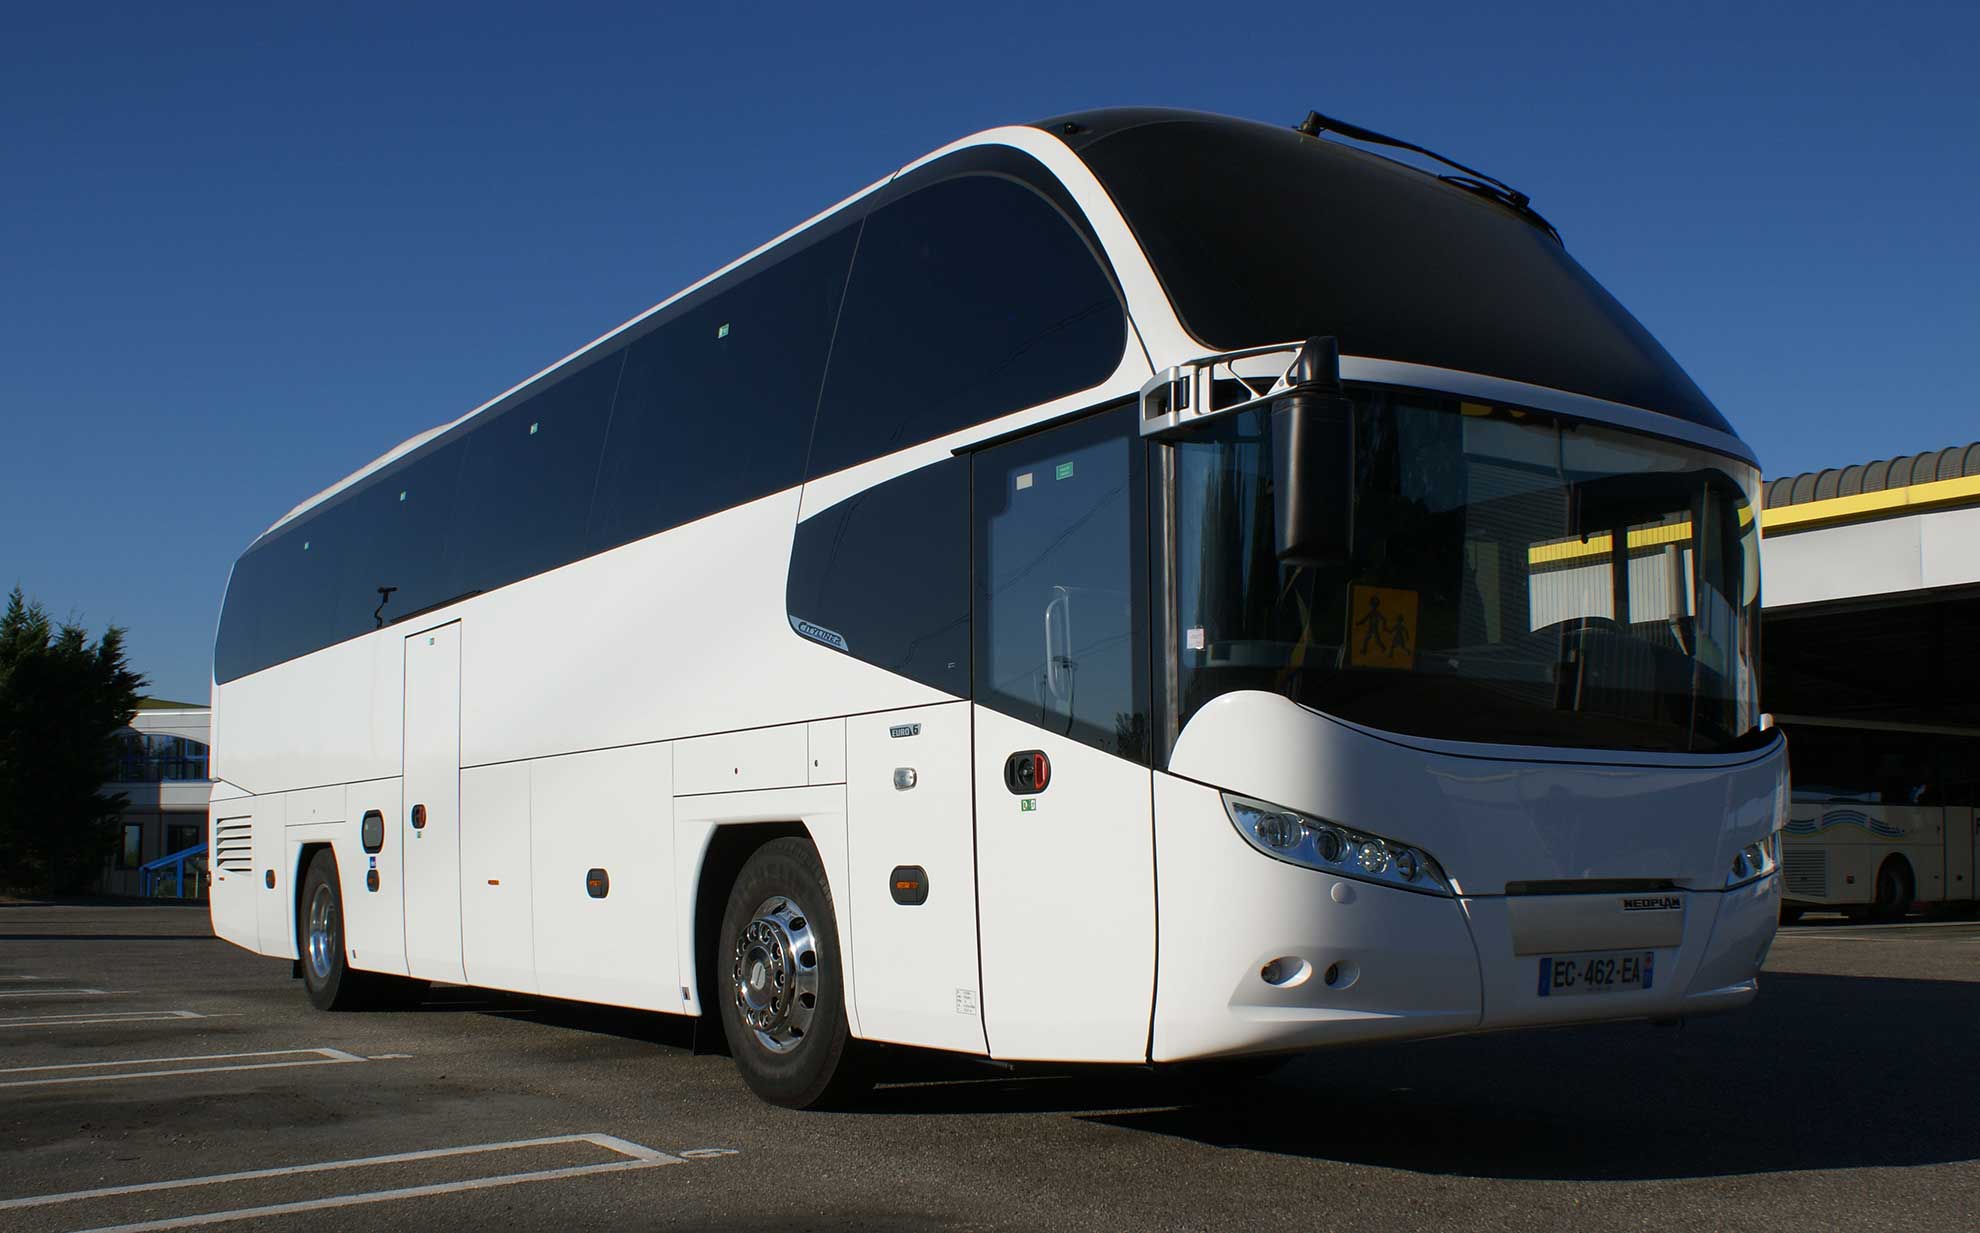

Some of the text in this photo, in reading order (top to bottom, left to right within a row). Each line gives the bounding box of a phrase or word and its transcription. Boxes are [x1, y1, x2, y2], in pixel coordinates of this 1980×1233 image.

[891, 724, 919, 737] EURO 6
[1624, 895, 1680, 910] NEOPLAN
[1554, 958, 1640, 987] EC-462-EA
